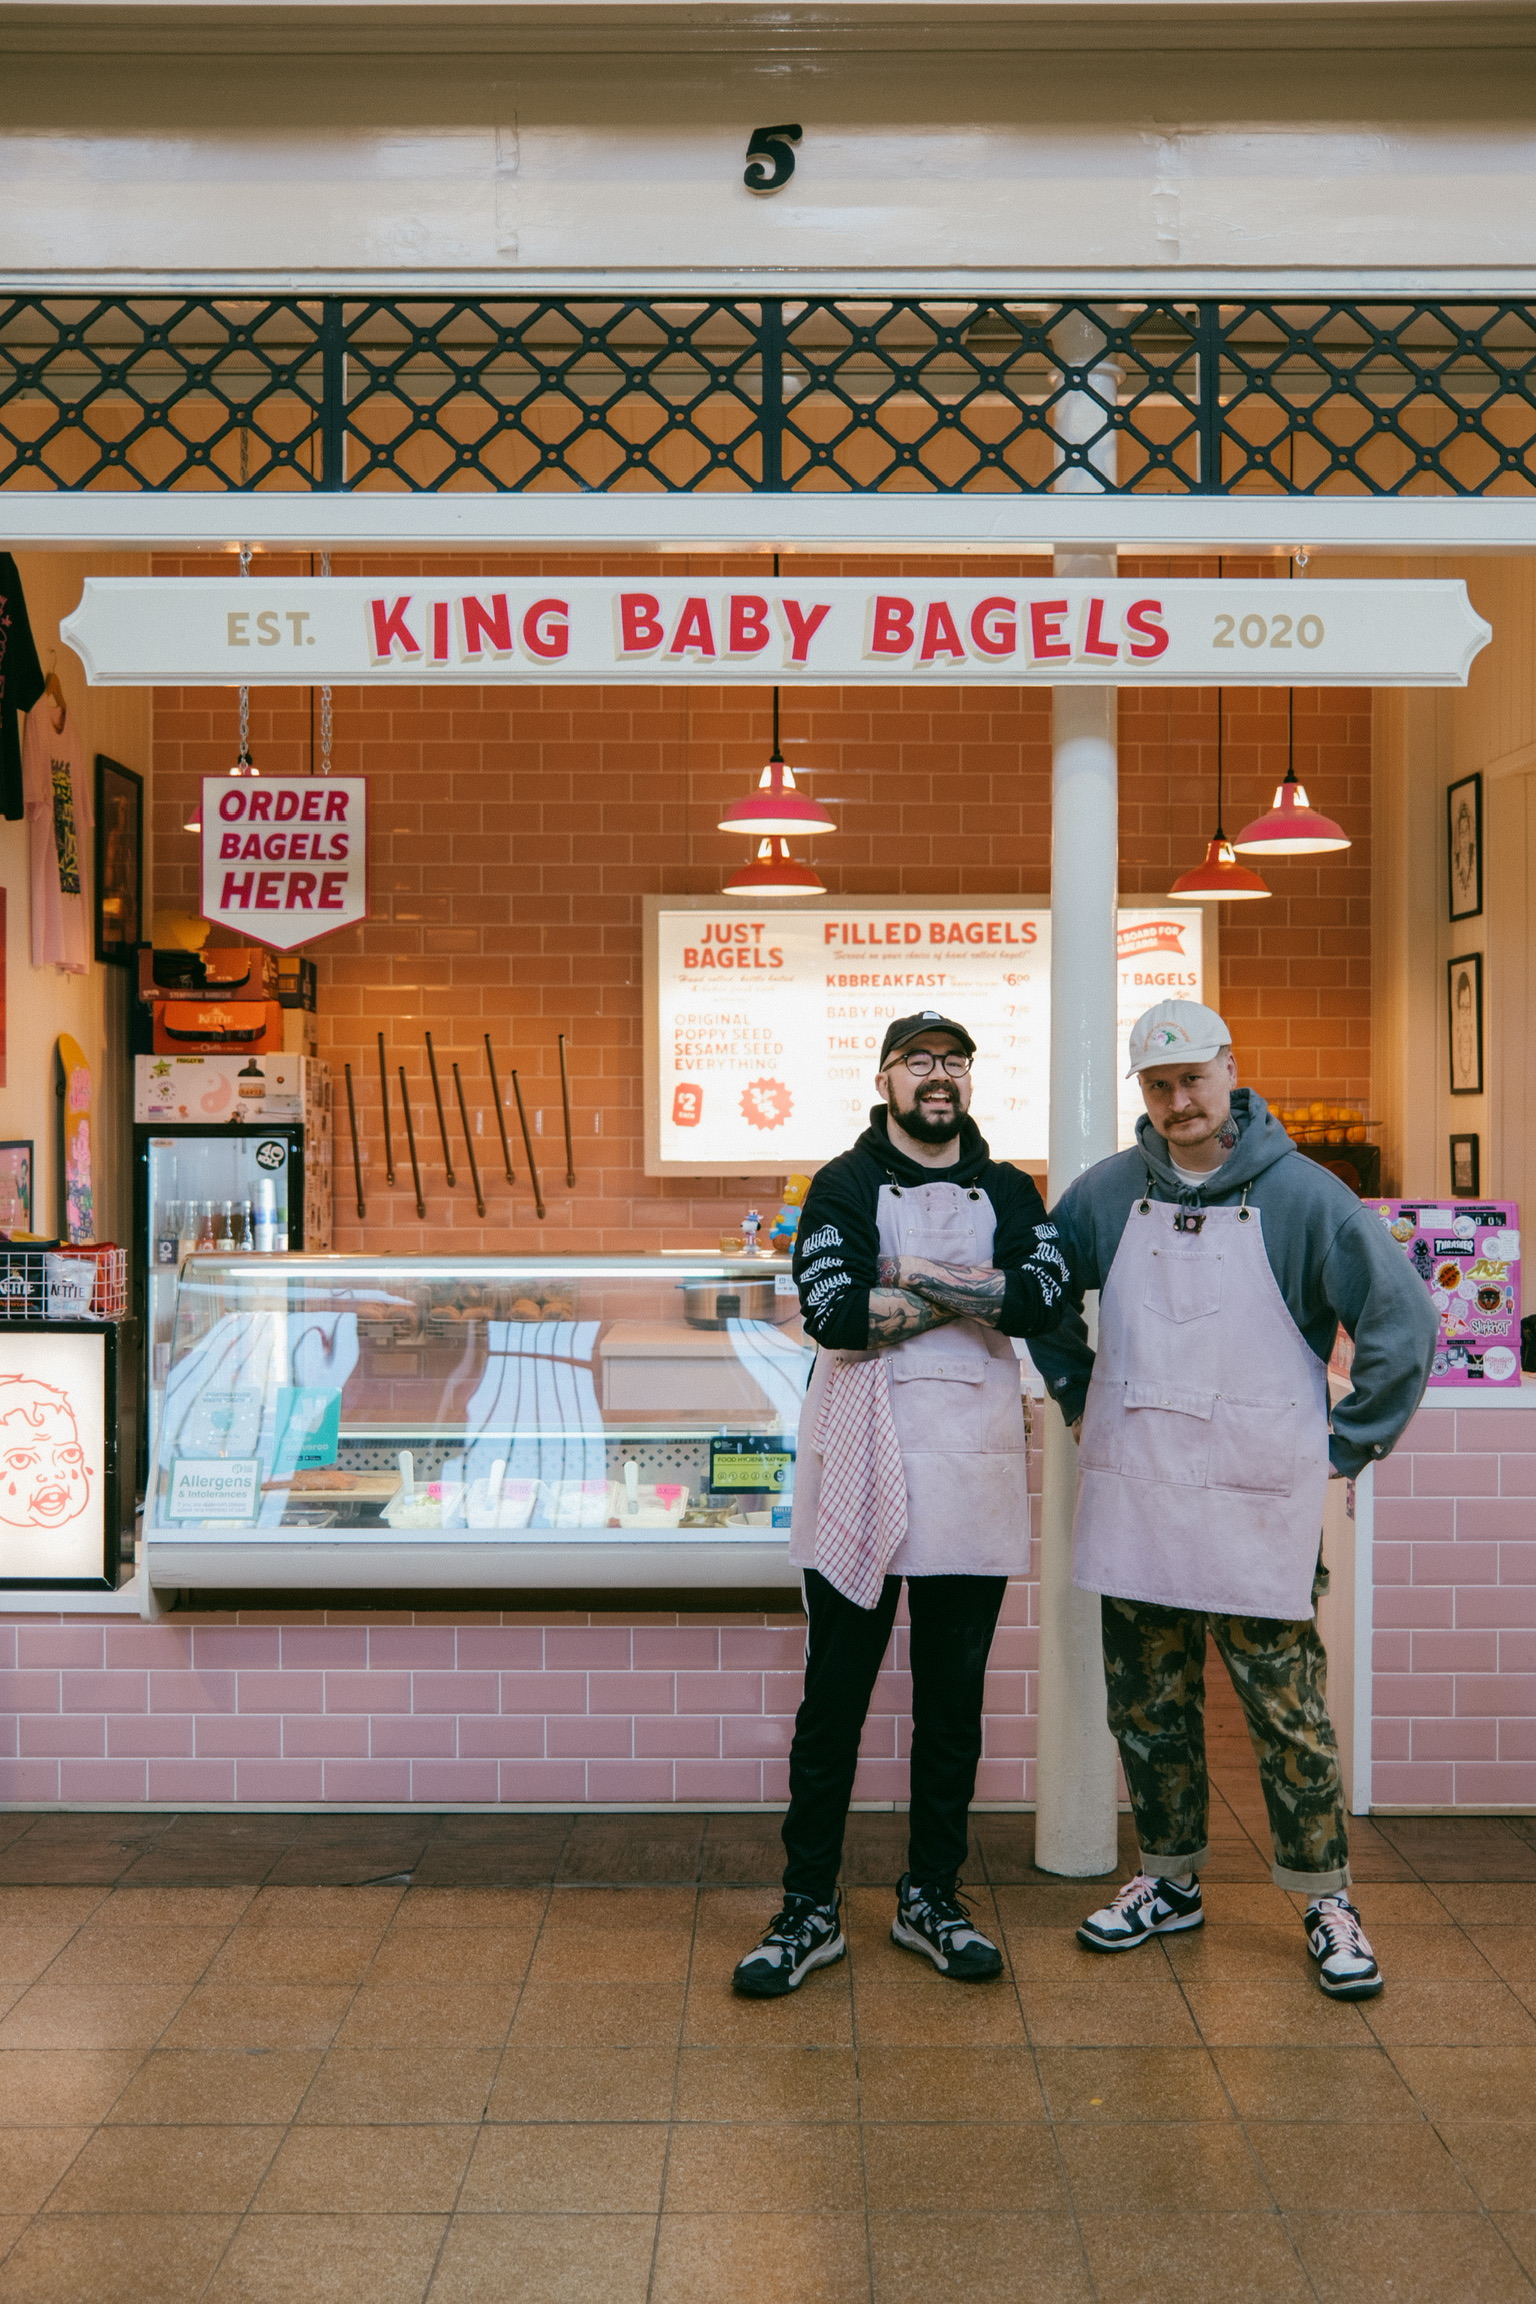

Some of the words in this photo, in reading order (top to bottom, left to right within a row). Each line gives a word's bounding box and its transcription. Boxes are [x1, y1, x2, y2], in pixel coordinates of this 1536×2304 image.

[744, 123, 803, 195] 5
[227, 611, 316, 646] EST.
[367, 592, 570, 667] KING
[618, 592, 831, 662] BABY
[869, 594, 1170, 664] BAGELS
[1212, 613, 1325, 649] 2020
[219, 789, 350, 822] ORDER
[219, 832, 349, 861] BAGELS
[219, 871, 349, 909] HERE
[700, 922, 766, 945] JUST
[824, 922, 922, 945] FILLED
[929, 922, 1038, 944] BAGELS
[683, 946, 785, 969] BAGELS
[826, 973, 946, 987] KBBREAKFAST
[1134, 972, 1197, 985] BAGELS
[674, 1013, 750, 1025] ORIGINAL
[827, 1006, 868, 1018] BABY
[674, 1028, 726, 1040] POPPY
[732, 1028, 773, 1040] SEED
[674, 1042, 739, 1056] SESAME
[743, 1042, 783, 1055] SEED
[828, 1036, 859, 1049] THE
[674, 1058, 777, 1070] EVERYTHING
[260, 1143, 284, 1161] 40
[179, 1475, 252, 1490] Allergens
[777, 1471, 784, 1482] 5
[178, 1490, 185, 1498] &
[188, 1490, 247, 1498] Intolerances
